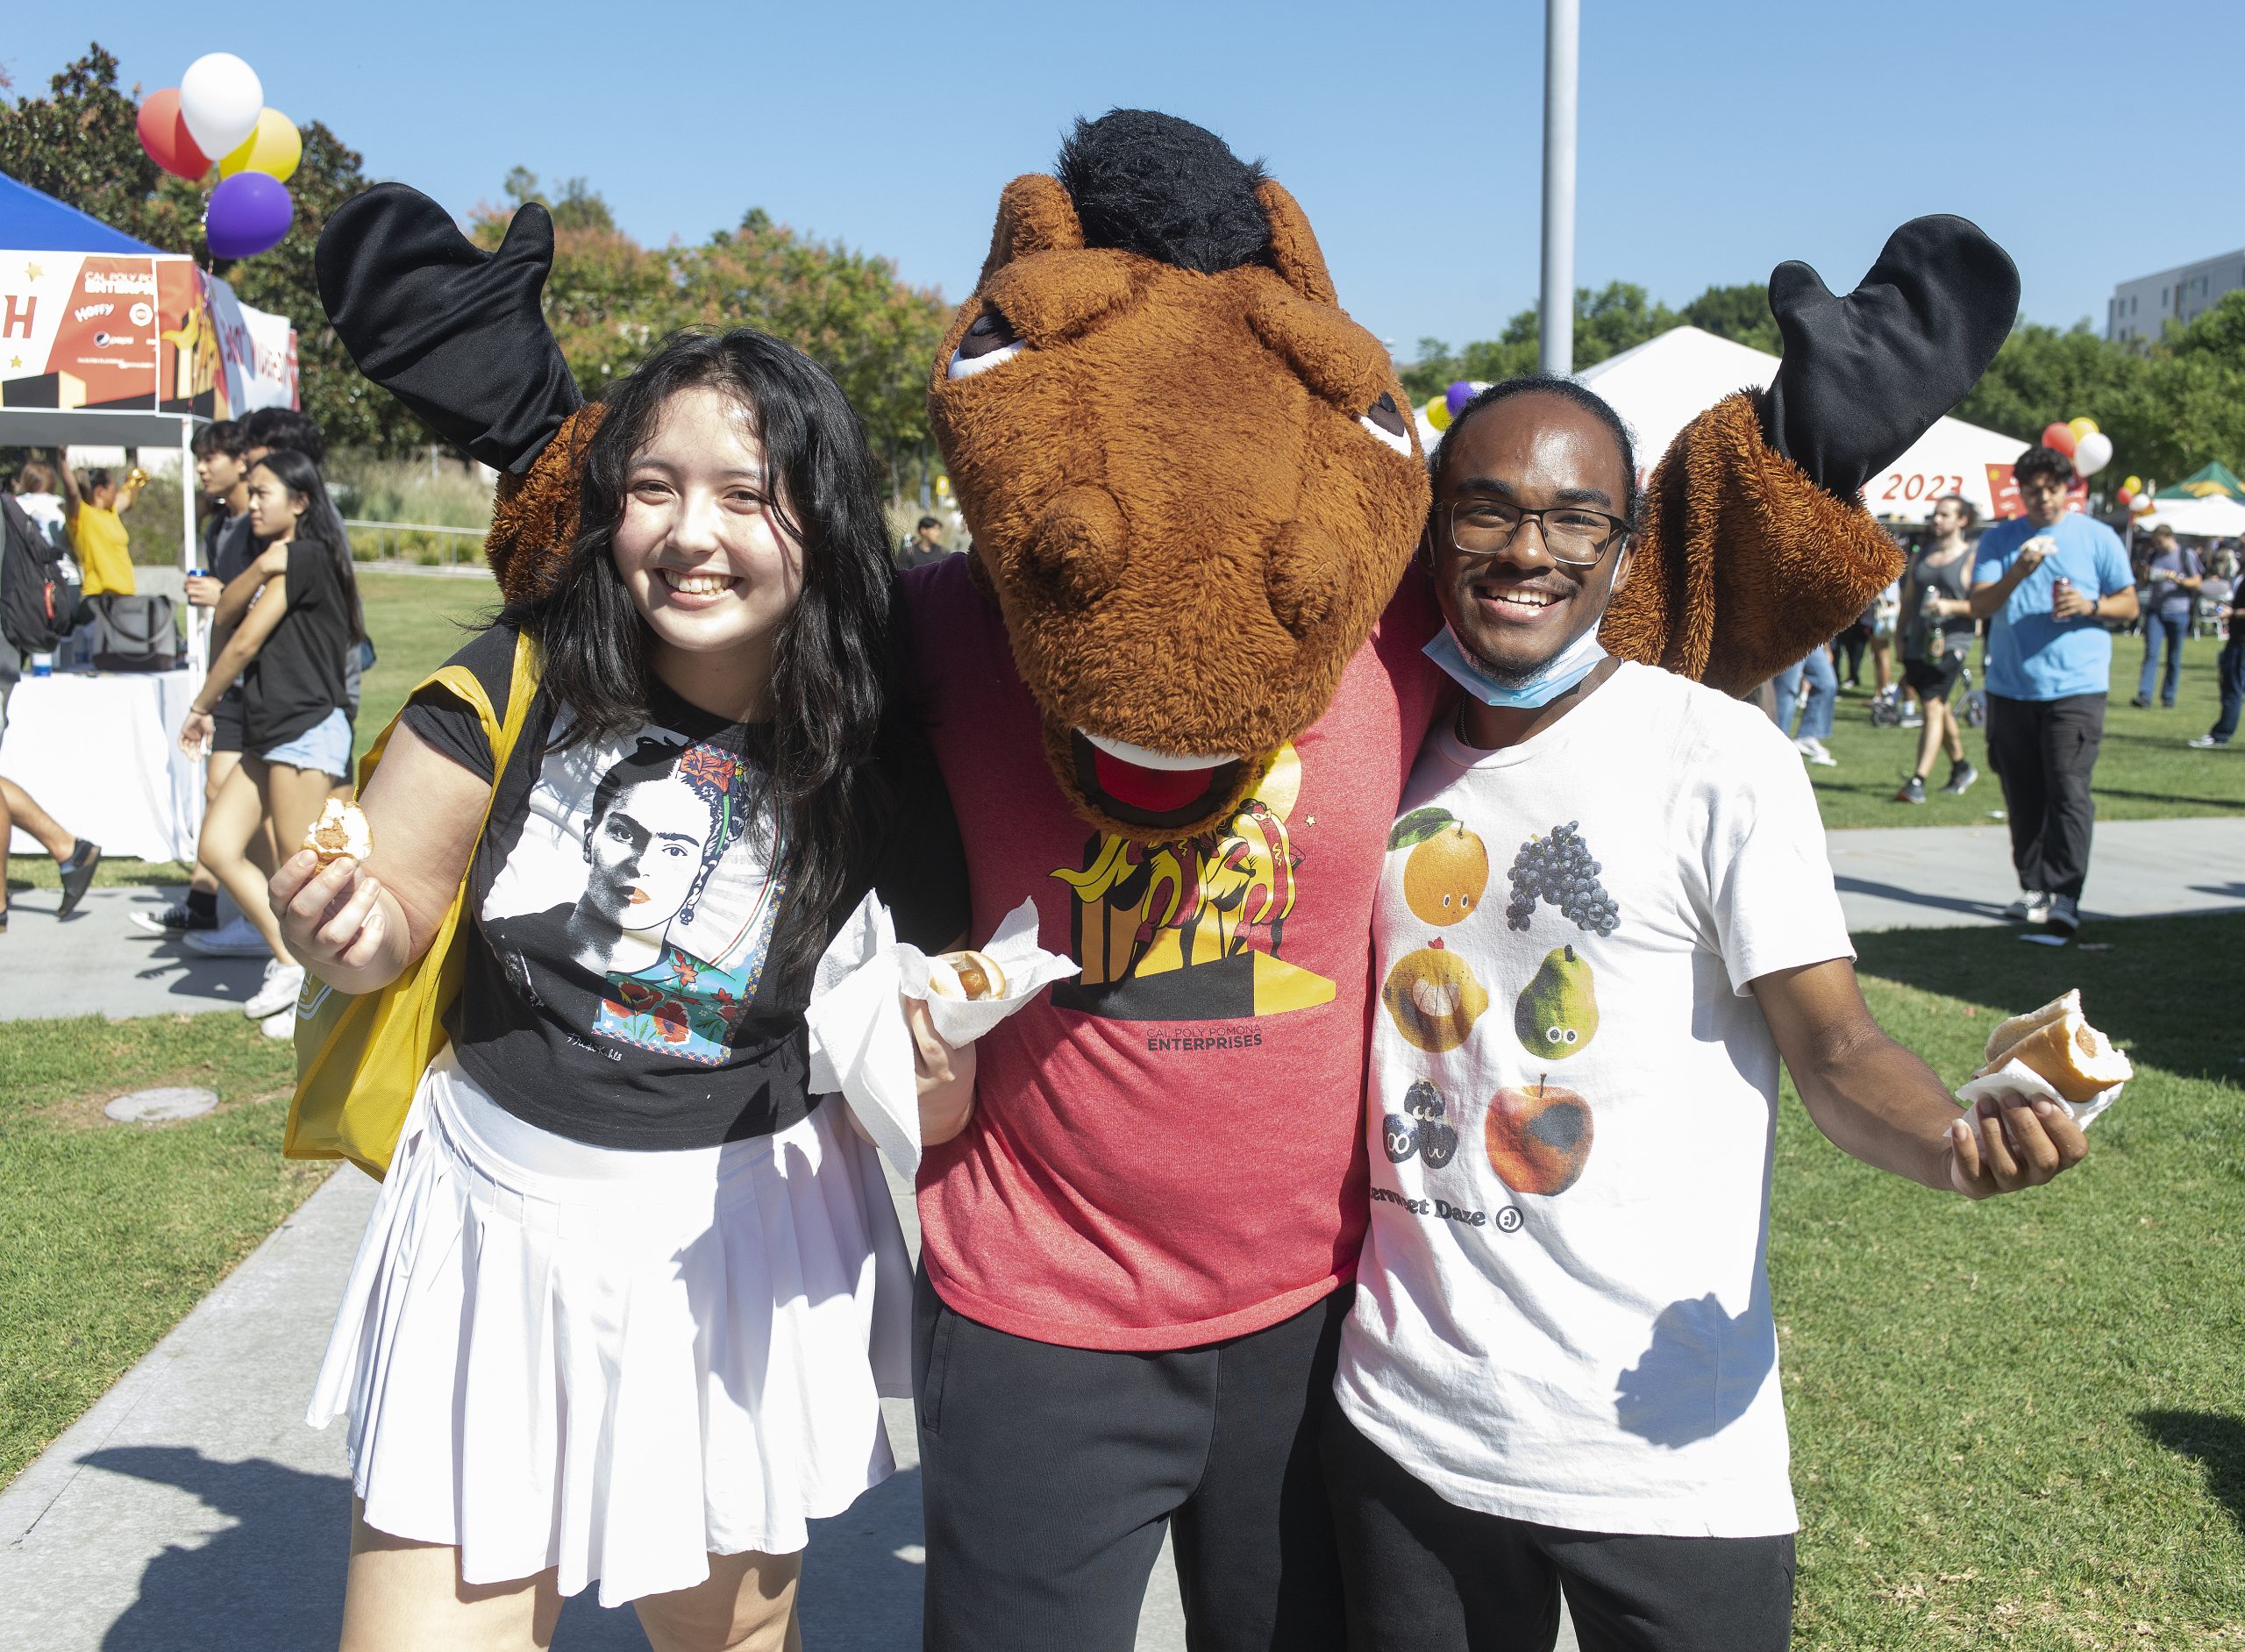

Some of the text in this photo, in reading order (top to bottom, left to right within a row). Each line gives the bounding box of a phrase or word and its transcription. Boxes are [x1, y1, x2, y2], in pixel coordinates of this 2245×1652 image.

[1882, 474, 1963, 501] 2023
[1147, 1024, 1261, 1038] CAL POLY POMONA
[1147, 1033, 1263, 1050] ENTERPRISES
[1435, 1199, 1486, 1227] Daze
